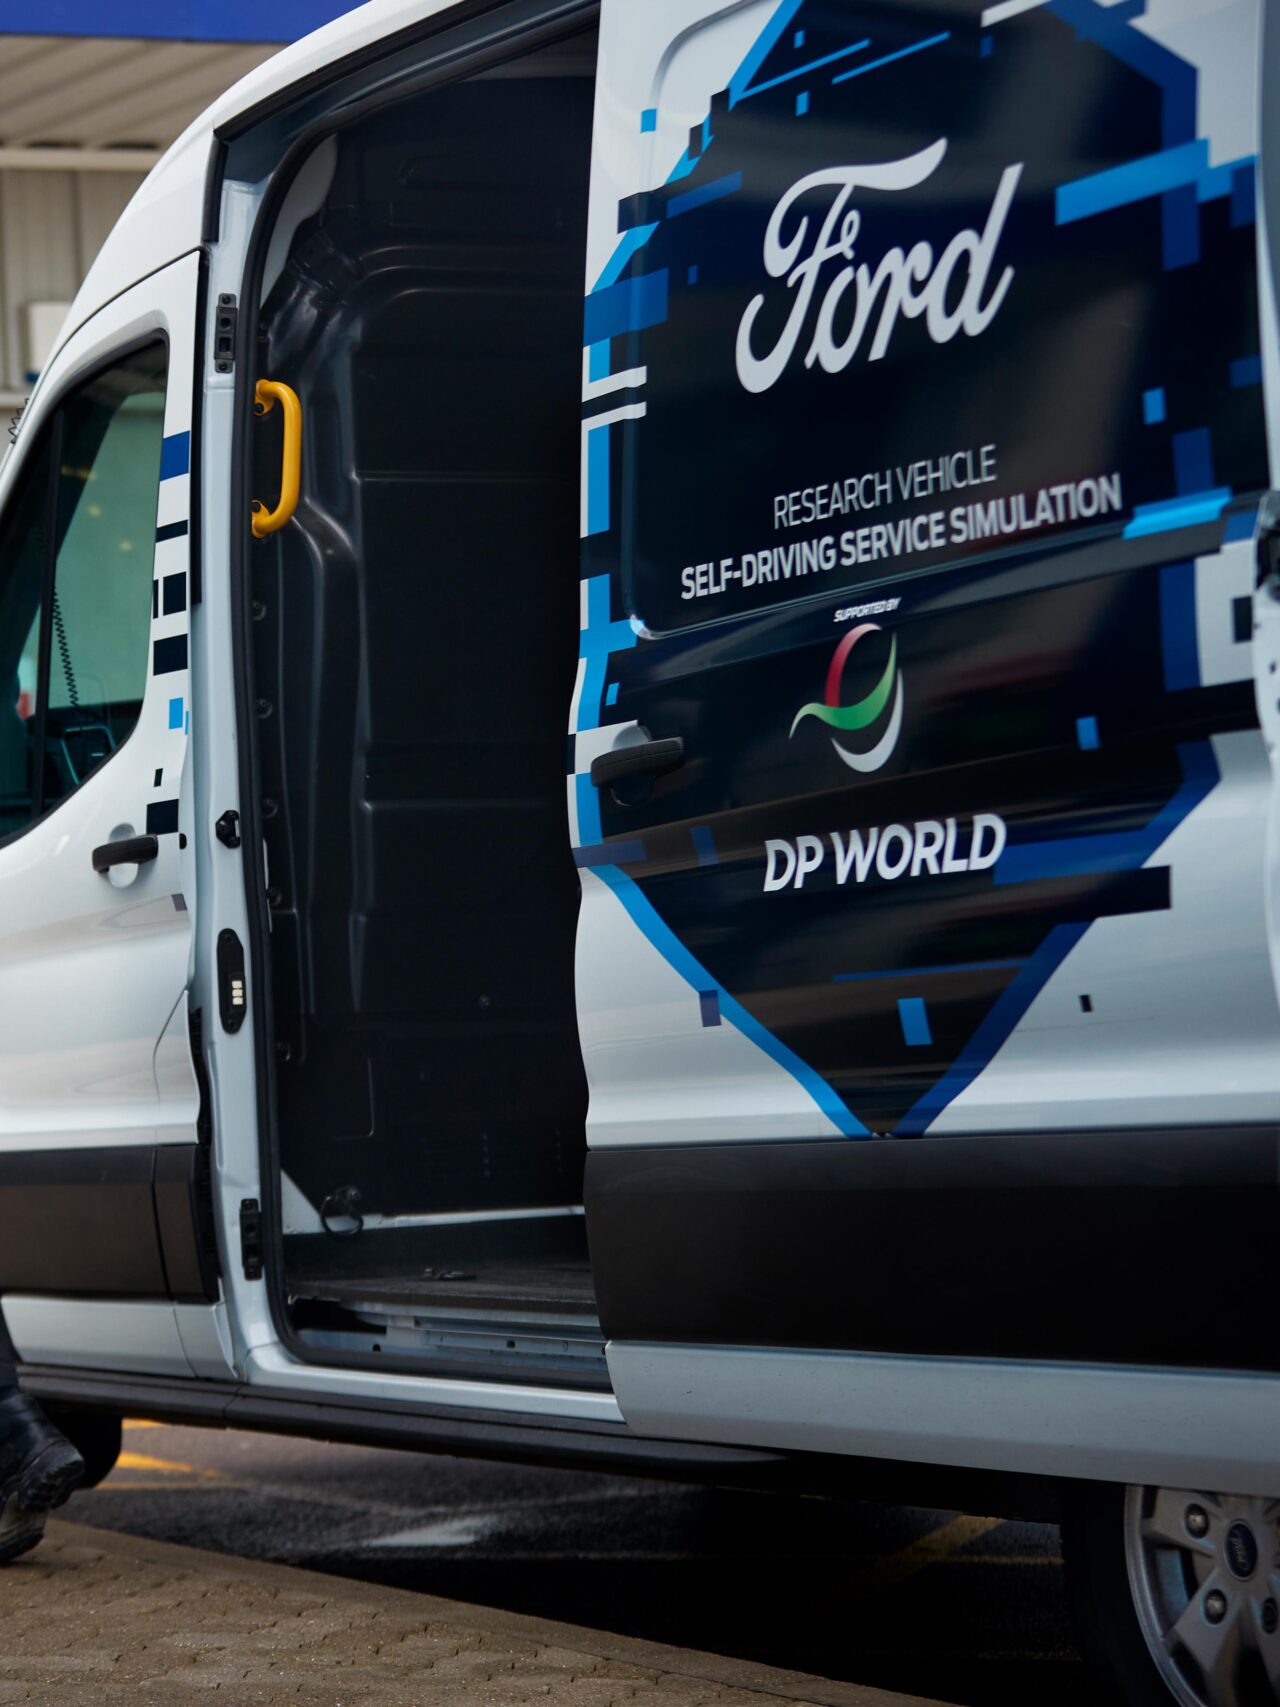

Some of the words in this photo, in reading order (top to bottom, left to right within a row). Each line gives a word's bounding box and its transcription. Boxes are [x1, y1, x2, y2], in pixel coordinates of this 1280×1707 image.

[735, 137, 1024, 394] Ford
[773, 469, 891, 529] RESEARCH
[896, 444, 997, 501] VEHICLE
[680, 536, 836, 600] SELF-DRIVING
[840, 512, 947, 566] SERVICE
[949, 473, 1121, 544] SIMULATION
[833, 600, 887, 622] SUPPORTED
[885, 597, 902, 611] BY
[763, 835, 824, 892] DP
[829, 813, 1008, 885] WORLD
